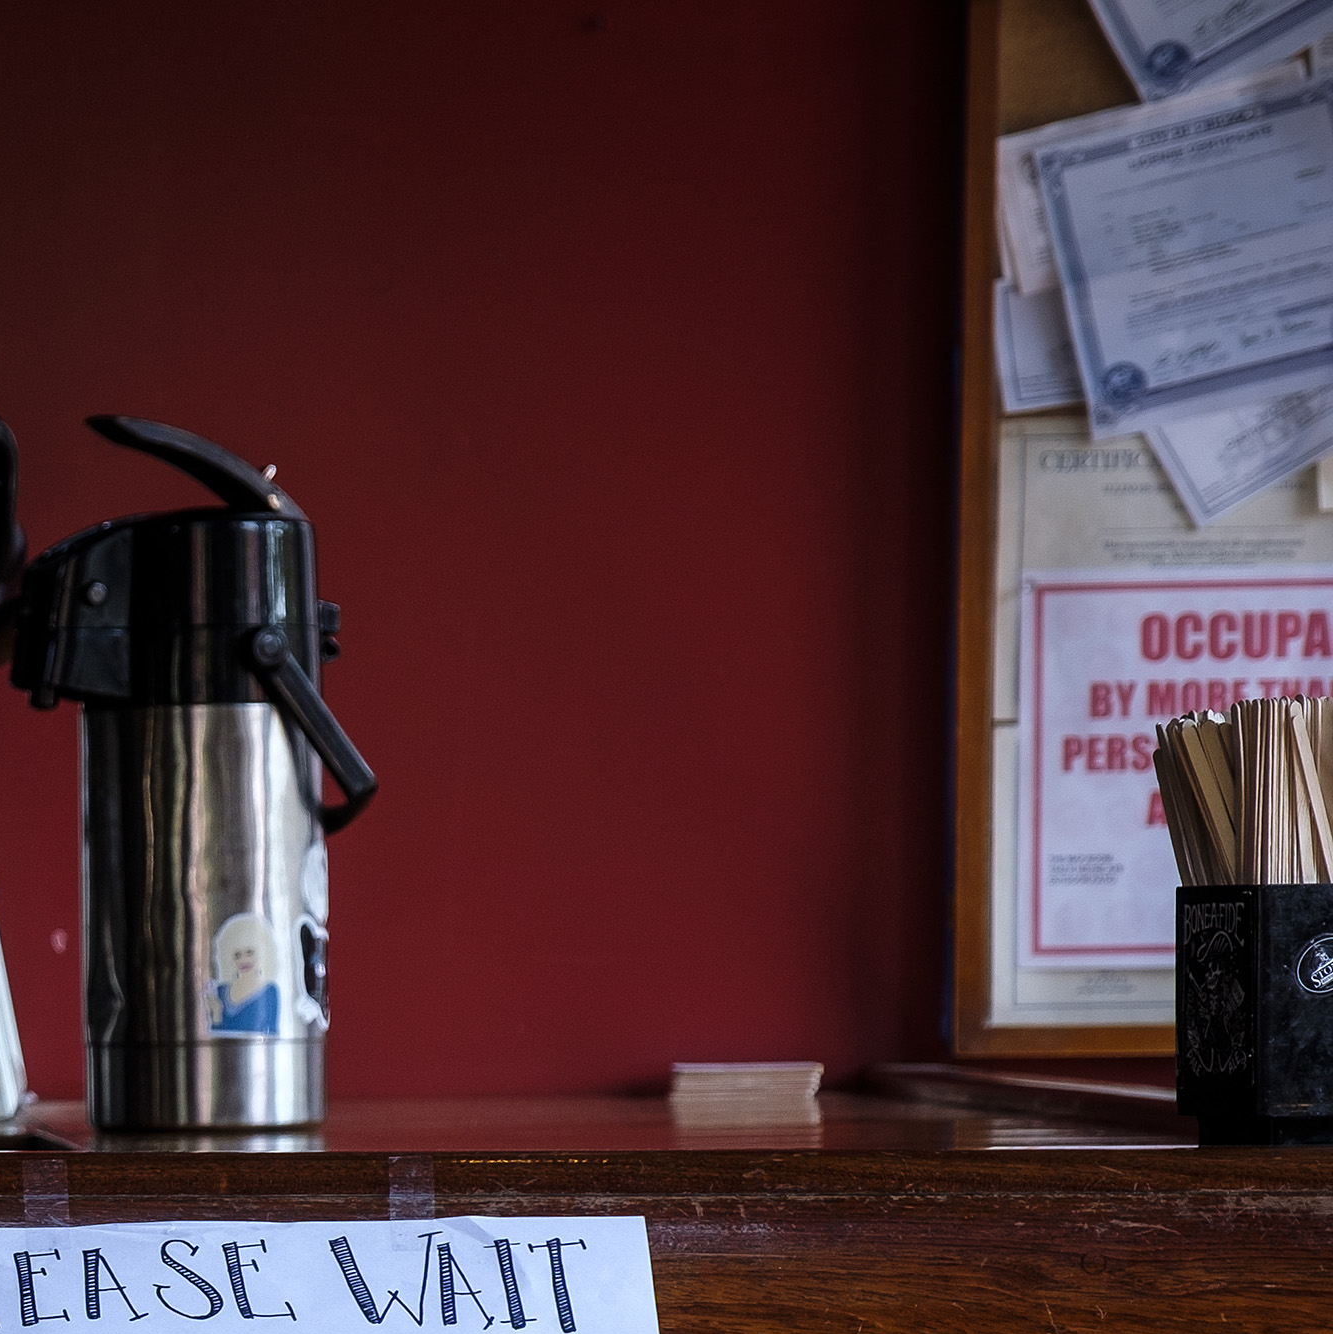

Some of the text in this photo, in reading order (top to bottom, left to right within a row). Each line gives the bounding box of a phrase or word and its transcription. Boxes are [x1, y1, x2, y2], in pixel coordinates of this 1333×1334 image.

[1089, 681, 1135, 717] BY
[1062, 735, 1161, 772] PERS
[1310, 961, 1333, 989] STO
[329, 1231, 587, 1334] WAIT
